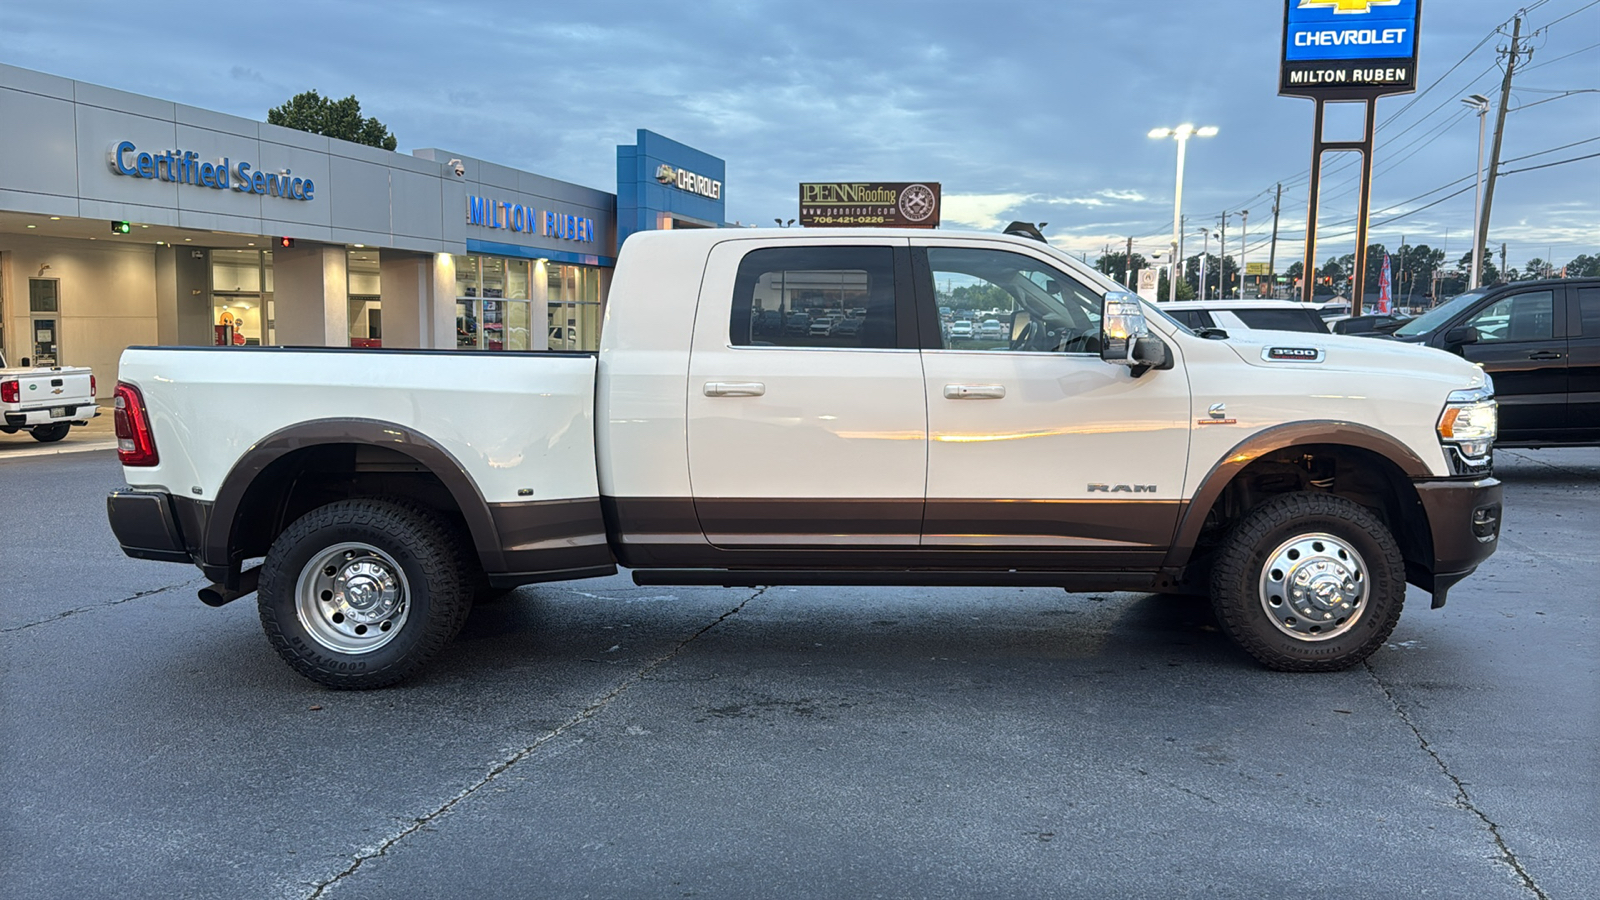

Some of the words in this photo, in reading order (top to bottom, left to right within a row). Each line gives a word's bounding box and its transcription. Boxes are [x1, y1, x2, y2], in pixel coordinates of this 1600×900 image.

[1294, 28, 1407, 46] CHEVROLET
[1290, 69, 1346, 83] MILTON
[1352, 68, 1406, 82] RUBEN
[113, 140, 230, 189] Certified
[235, 163, 315, 201] Service
[677, 168, 722, 200] CHEVROLET
[802, 184, 868, 202] PENN
[859, 186, 896, 205] Roofing
[468, 194, 536, 235] MILTON
[544, 210, 594, 243] RUBEN
[812, 216, 884, 224] 706-421-0226
[1273, 348, 1316, 357] 3500
[1087, 483, 1157, 493] RAM
[291, 636, 367, 672] GOODYEAR
